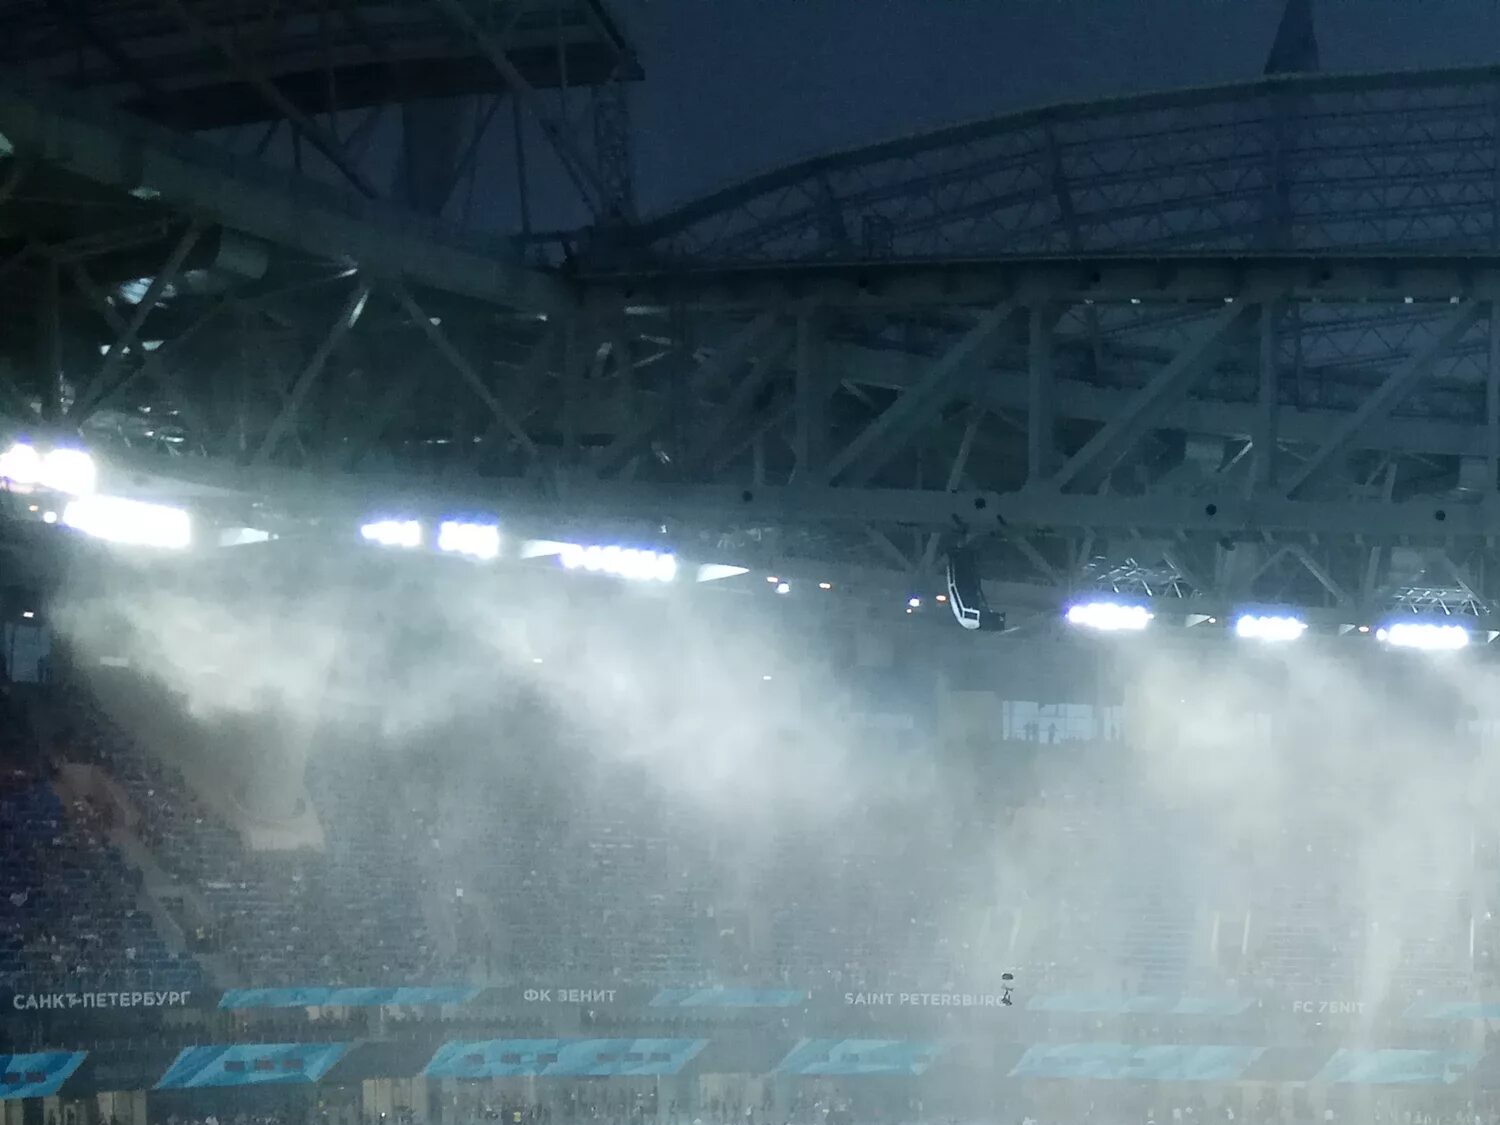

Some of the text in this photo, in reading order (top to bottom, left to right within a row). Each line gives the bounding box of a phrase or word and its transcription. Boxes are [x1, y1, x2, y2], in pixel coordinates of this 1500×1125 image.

[13, 991, 191, 1010] САНКТ-ПЕТЕРБУРГ
[524, 989, 616, 1003] ФК ЗЕНИТ
[844, 992, 894, 1005] SAINT
[1293, 1001, 1314, 1014] FC
